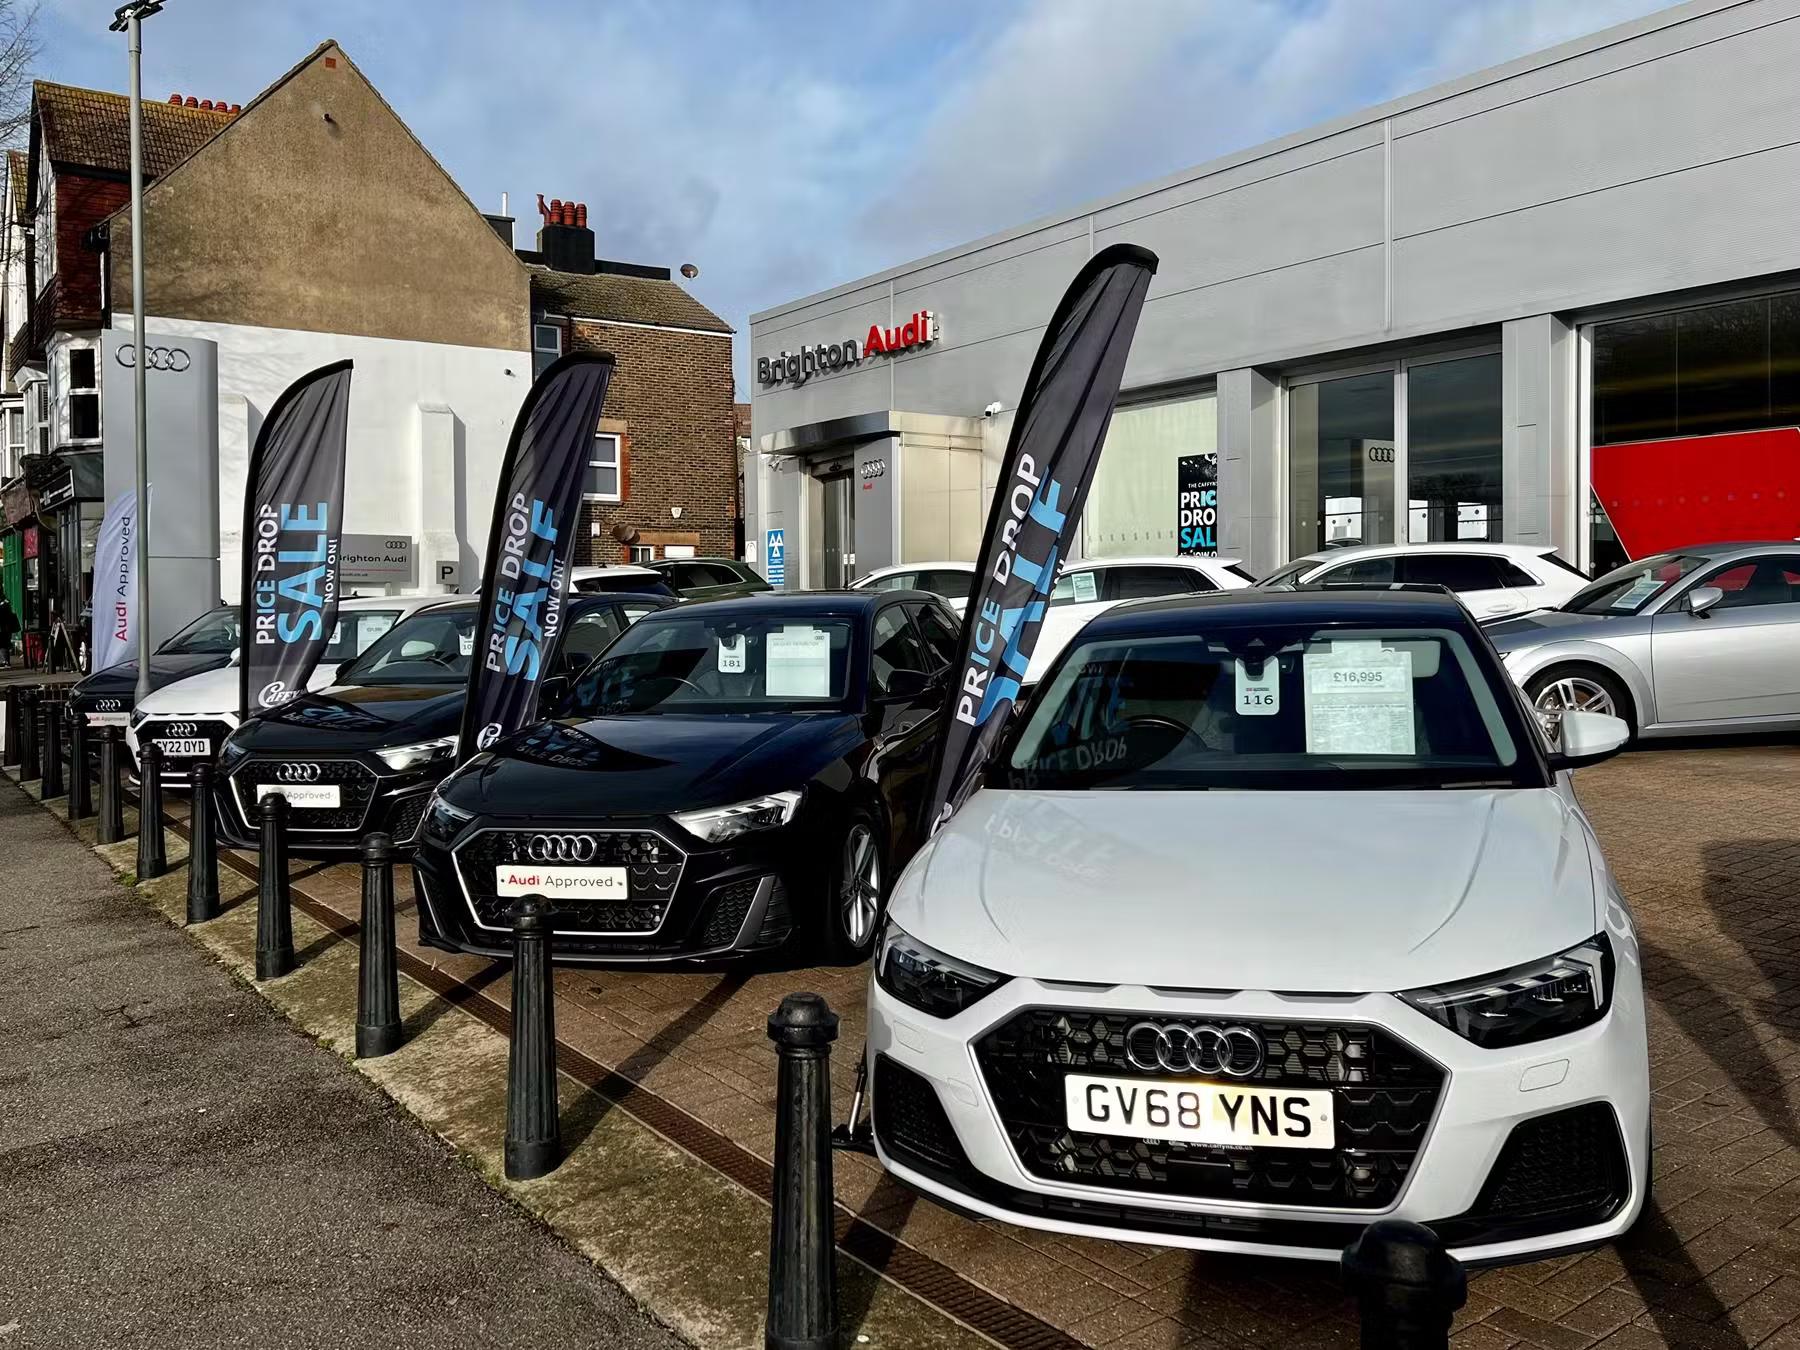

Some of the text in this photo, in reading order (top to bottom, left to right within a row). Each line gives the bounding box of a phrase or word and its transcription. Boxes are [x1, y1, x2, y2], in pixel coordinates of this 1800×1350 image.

[757, 310, 930, 384] Brighton Audi
[1180, 490, 1217, 508] PRIC
[1180, 508, 1217, 527] DRO
[1180, 527, 1217, 548] SAL
[383, 555, 407, 563] Audi
[115, 516, 131, 641] Audi Approved
[256, 503, 279, 645] PRICE DROP
[278, 502, 328, 644] SALE
[324, 539, 338, 603] NOW ON!
[441, 566, 454, 580] P
[486, 492, 529, 673] PRICE DROP
[956, 452, 1040, 727] PRICE DROP
[544, 558, 565, 637] NOW ON!
[1333, 671, 1383, 684] £16,995
[1243, 695, 1274, 705] 116
[184, 741, 205, 753] OYD
[286, 791, 331, 800] Approved
[508, 874, 613, 888] Audi Approved
[1085, 1083, 1312, 1138] GV68 YNS
